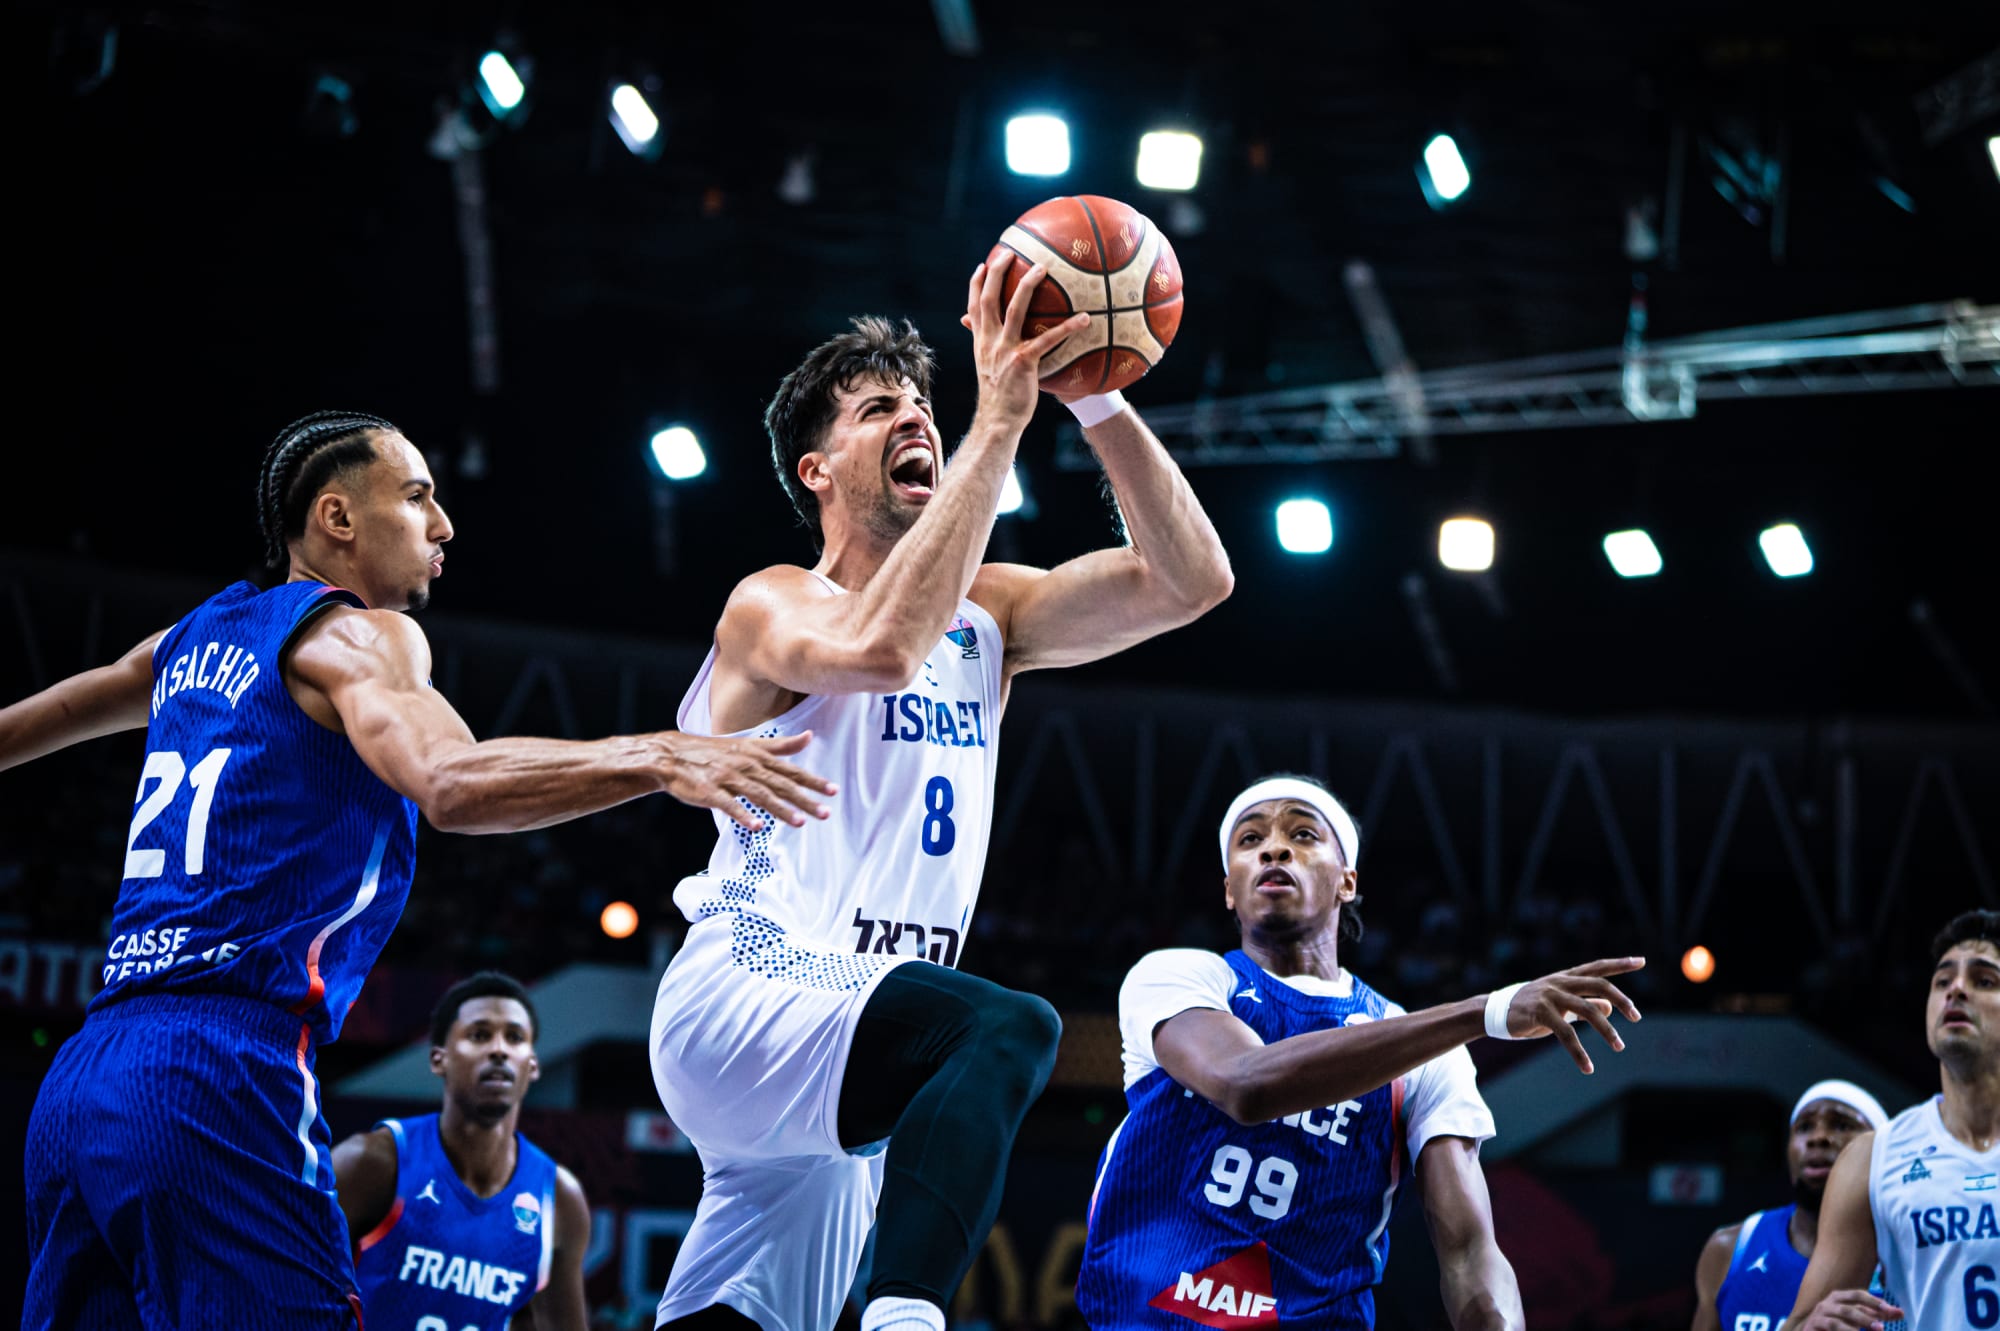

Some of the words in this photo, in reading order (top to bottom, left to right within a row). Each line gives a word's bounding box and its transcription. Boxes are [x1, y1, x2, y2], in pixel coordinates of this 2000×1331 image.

[881, 693, 985, 748] ISRAEL
[122, 748, 232, 881] 21
[921, 775, 956, 857] 8
[108, 927, 191, 960] CAISSE
[852, 907, 960, 969] הראל
[1203, 1144, 1299, 1221] 99
[1910, 1203, 2000, 1249] ISRA
[399, 1246, 527, 1306] FRANCE
[1174, 1271, 1277, 1318] MAIF
[1963, 1264, 2000, 1330] 6
